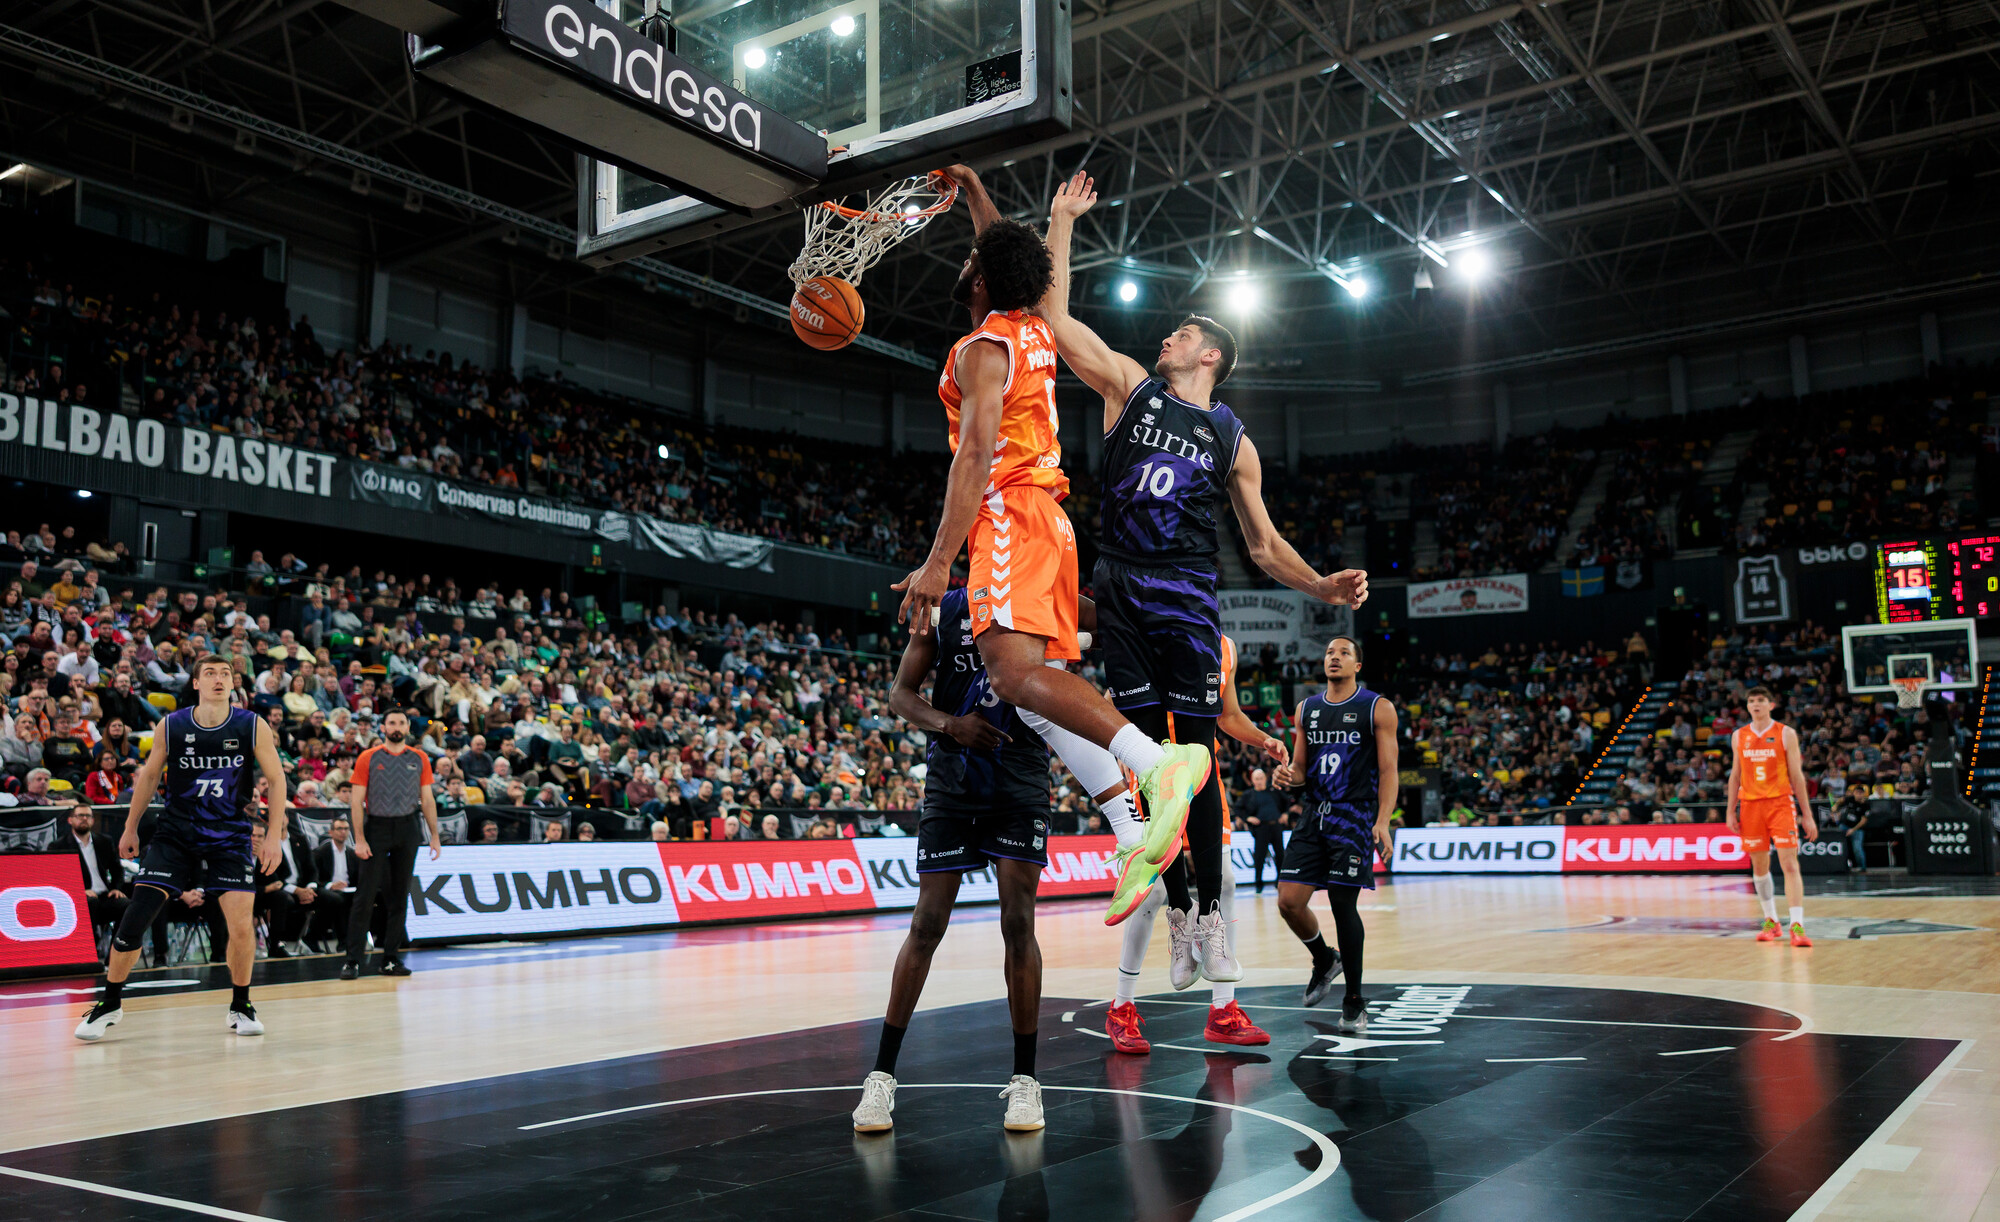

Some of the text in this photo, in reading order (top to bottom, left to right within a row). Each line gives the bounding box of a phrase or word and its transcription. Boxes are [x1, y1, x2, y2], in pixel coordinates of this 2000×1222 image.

[545, 4, 761, 151] endesa
[0, 392, 337, 497] BILBAO BASKET
[1129, 424, 1214, 472] surne
[380, 475, 423, 500] IMQ
[1136, 462, 1175, 497] 10
[438, 481, 515, 517] Conservas
[518, 498, 591, 530] Cusumano
[1750, 574, 1770, 595] 14
[1893, 568, 1924, 588] 15
[1168, 691, 1199, 703] NISSAN
[1307, 730, 1361, 745] surne
[179, 754, 244, 769] surne
[1320, 753, 1341, 775] 19
[1756, 766, 1766, 781] 5
[196, 778, 224, 797] 73
[1400, 840, 1556, 861] KUMHO
[1565, 835, 1746, 862] KUMHO
[409, 867, 662, 916] KUMHO
[669, 858, 866, 903] KUMHO
